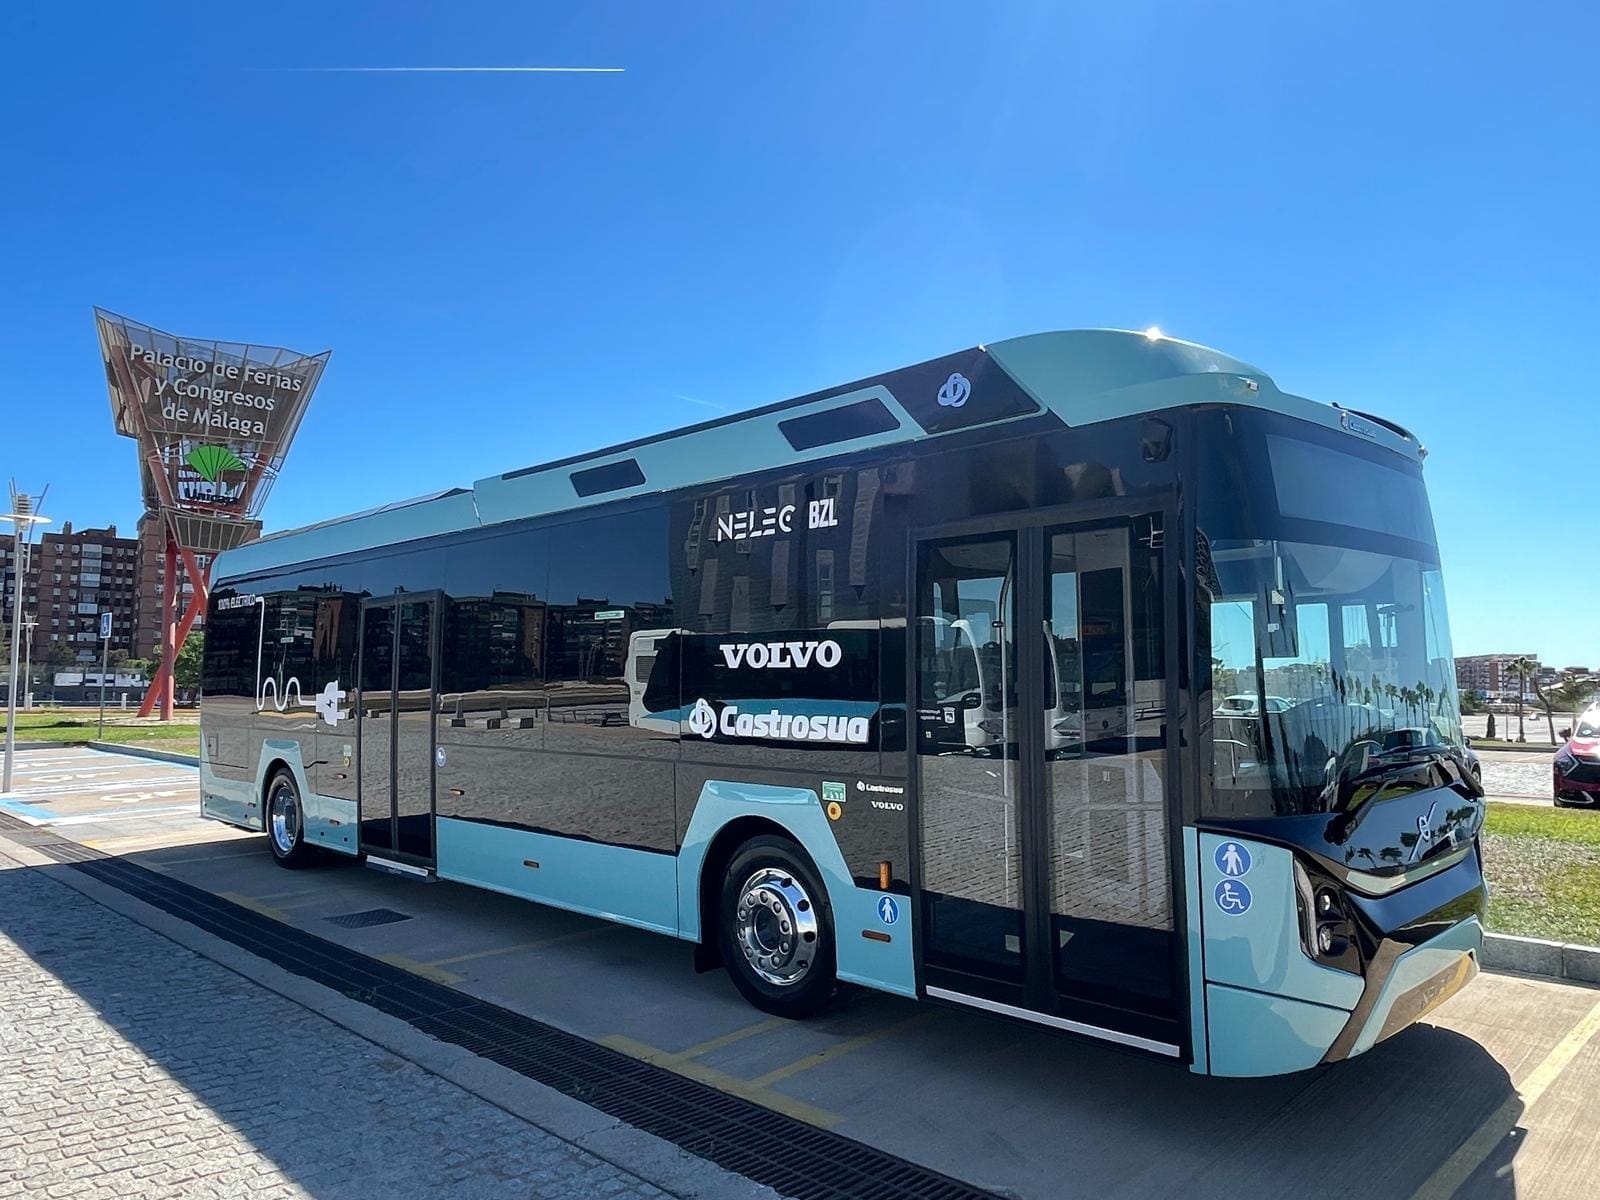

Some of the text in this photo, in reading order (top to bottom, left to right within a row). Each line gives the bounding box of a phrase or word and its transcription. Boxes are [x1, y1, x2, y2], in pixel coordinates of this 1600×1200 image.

[130, 343, 302, 392] Palacio de Ferias
[154, 378, 276, 411] y Congresos
[162, 403, 265, 437] de Málaga
[717, 498, 838, 542] NELEC BZL
[719, 639, 842, 669] VOLVO
[719, 705, 869, 744] Castrosua
[865, 783, 904, 794] Castrosua
[871, 800, 904, 811] VOLVO
